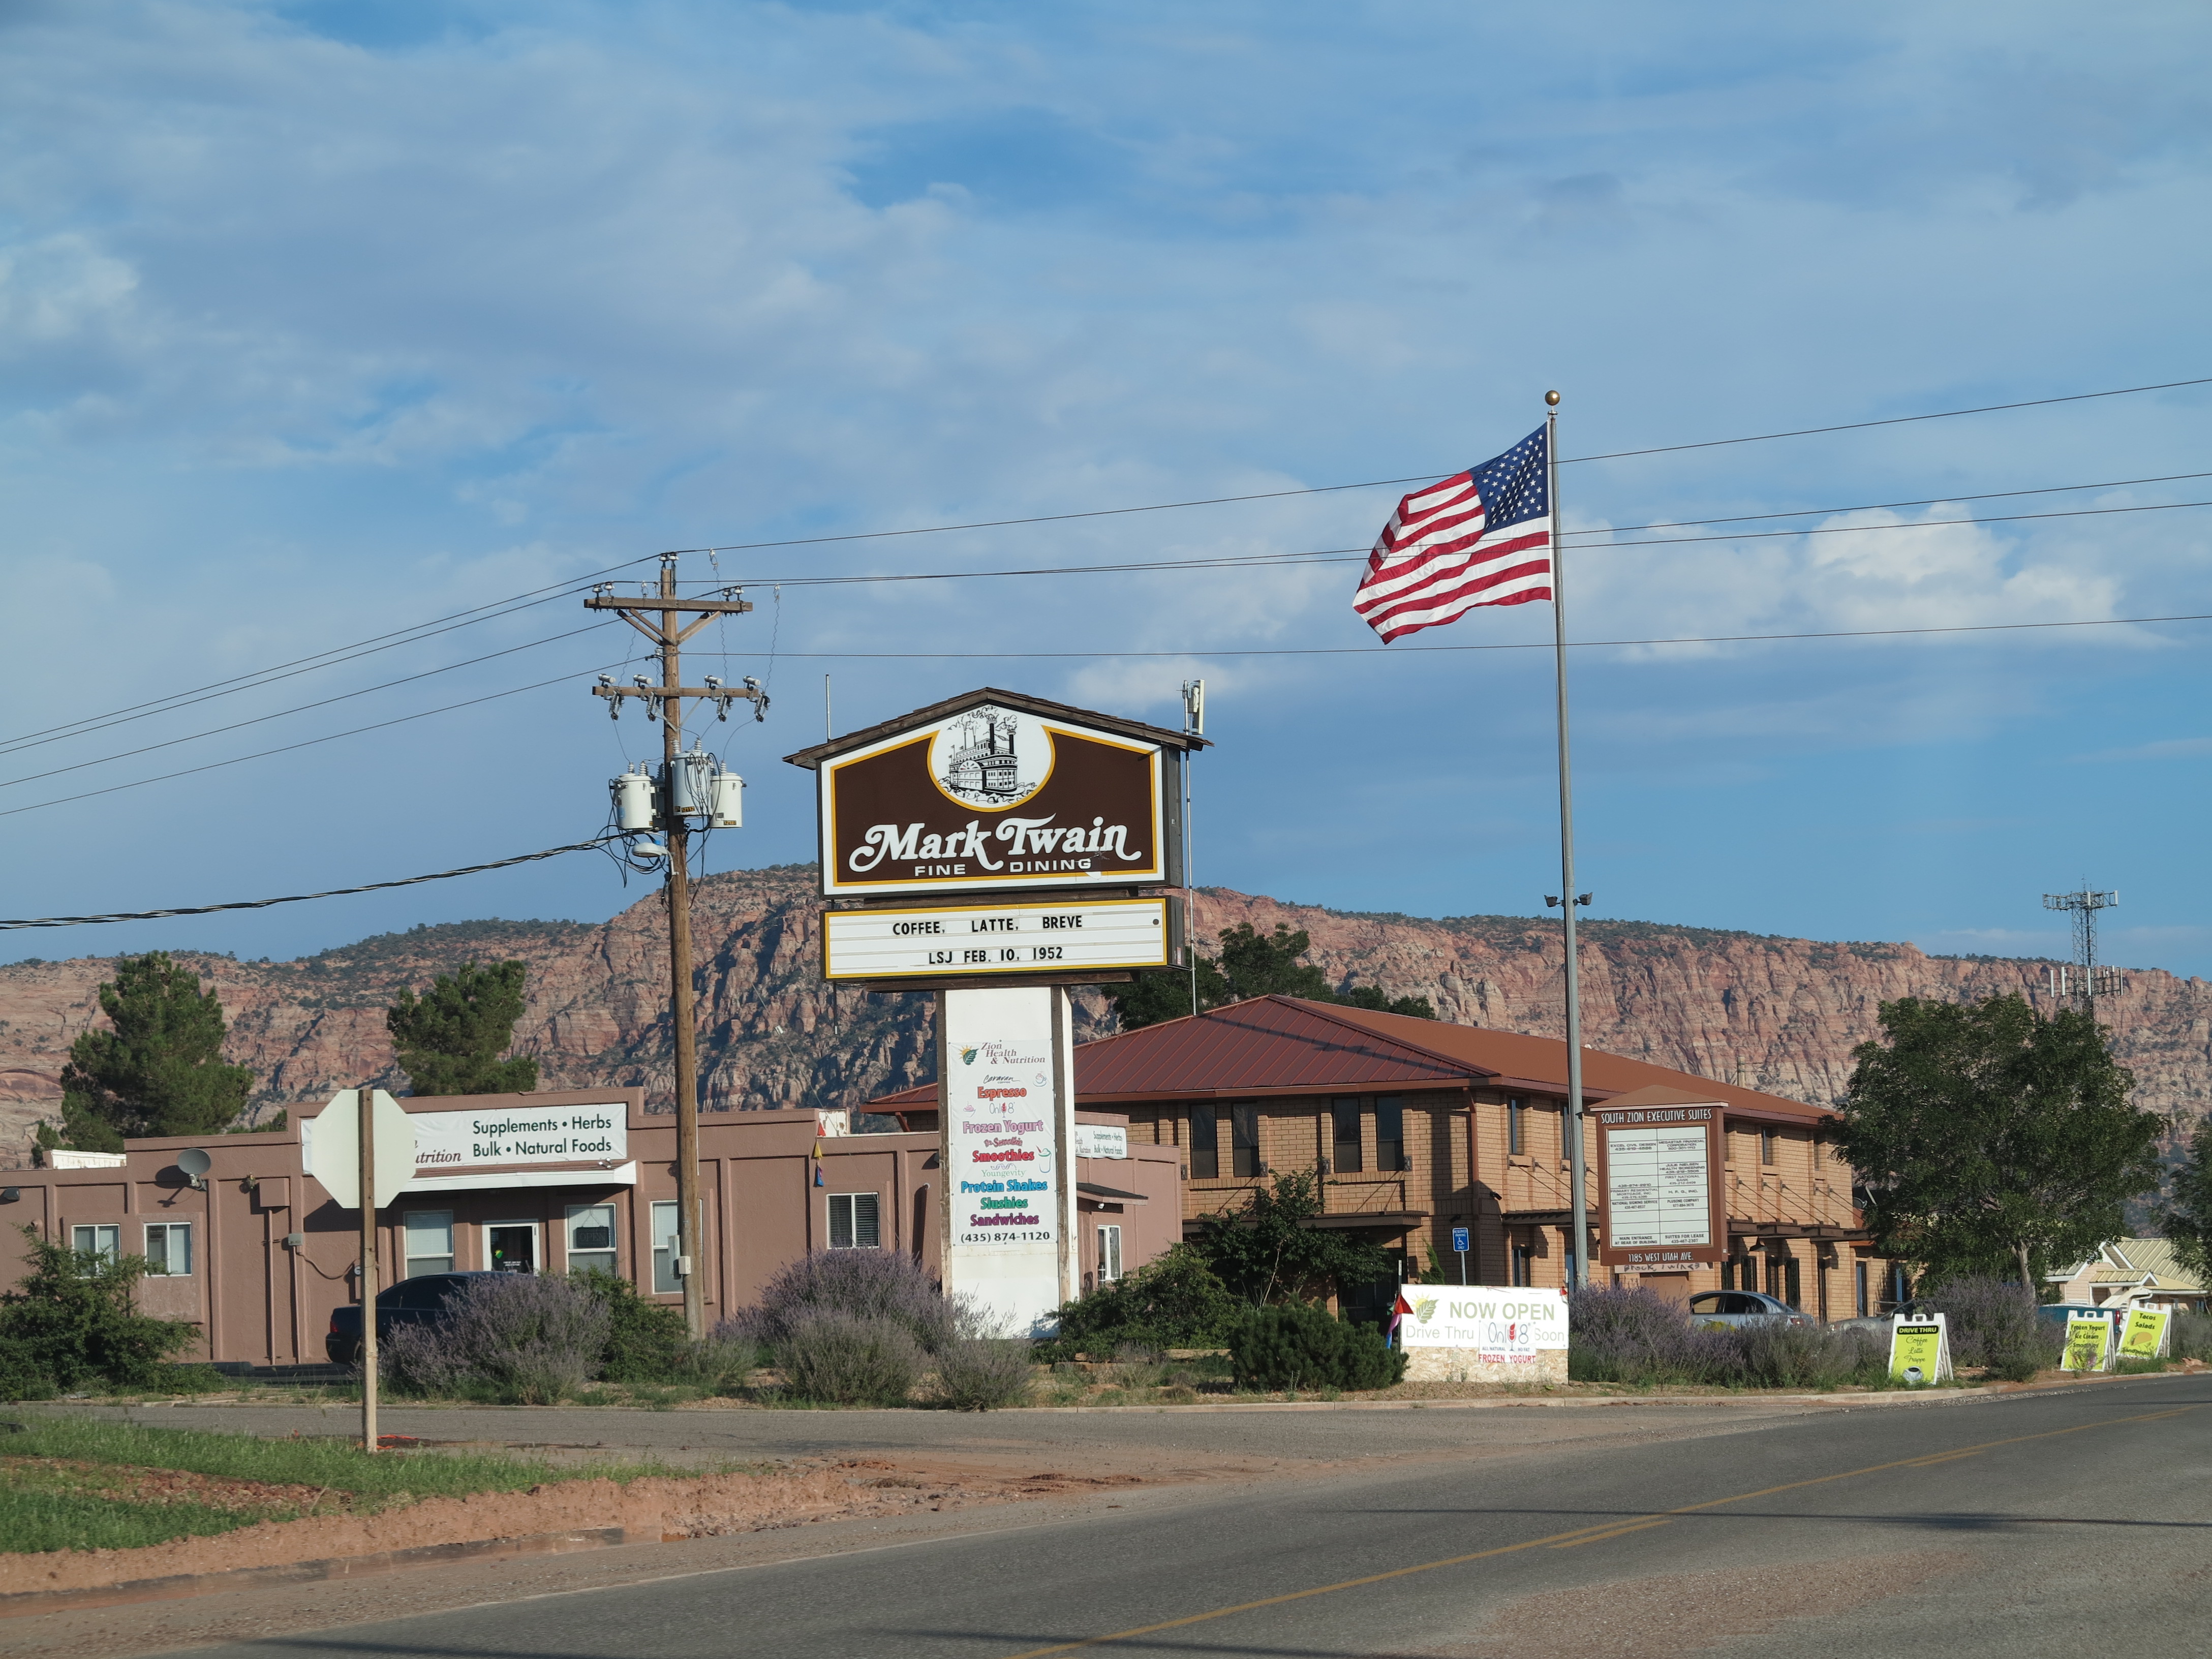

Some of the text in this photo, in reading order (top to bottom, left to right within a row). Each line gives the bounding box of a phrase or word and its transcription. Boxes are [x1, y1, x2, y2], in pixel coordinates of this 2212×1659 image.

[848, 812, 1142, 873] Mark Twain
[914, 858, 1091, 877] FINE DINING
[893, 915, 1082, 935] COFFEE, LATTE, BREVE
[929, 951, 953, 964] LSJ
[964, 949, 991, 963] FEB.
[1033, 946, 1063, 960] 1952
[981, 1042, 1002, 1050] Zion
[986, 1049, 1017, 1058] Health
[1002, 1056, 1046, 1064] Nutrition
[983, 1074, 1020, 1084] Caravan
[977, 1086, 1027, 1101] Espresso
[1601, 1109, 1712, 1124] SOUTH ZION EXECUTIVE SUITES
[473, 1113, 611, 1138] Supplements Herbs
[963, 1119, 1043, 1135] Frozen Yogurt
[473, 1136, 611, 1157] Bulk Natural Foods
[415, 1149, 462, 1164] trition
[972, 1149, 1035, 1162] Smoothies
[981, 1169, 1026, 1178] Youngevity
[961, 1178, 1048, 1193] Protein Shakes
[980, 1195, 1029, 1210] Slushies
[970, 1212, 1039, 1227] Sandwiches
[961, 1231, 1050, 1244] (435) 874-1120
[1629, 1252, 1694, 1262] 1185 WEST UTAH AVE.
[1450, 1301, 1554, 1320] NOW OPEN
[2139, 1312, 2156, 1320] Tacos
[1406, 1325, 1564, 1341] Drive Thru Soon
[2135, 1322, 2155, 1330] Salads
[1906, 1336, 1928, 1346] Coffee
[1479, 1354, 1536, 1364] FROZEN YOGURT
[1903, 1355, 1926, 1364] Frappe
